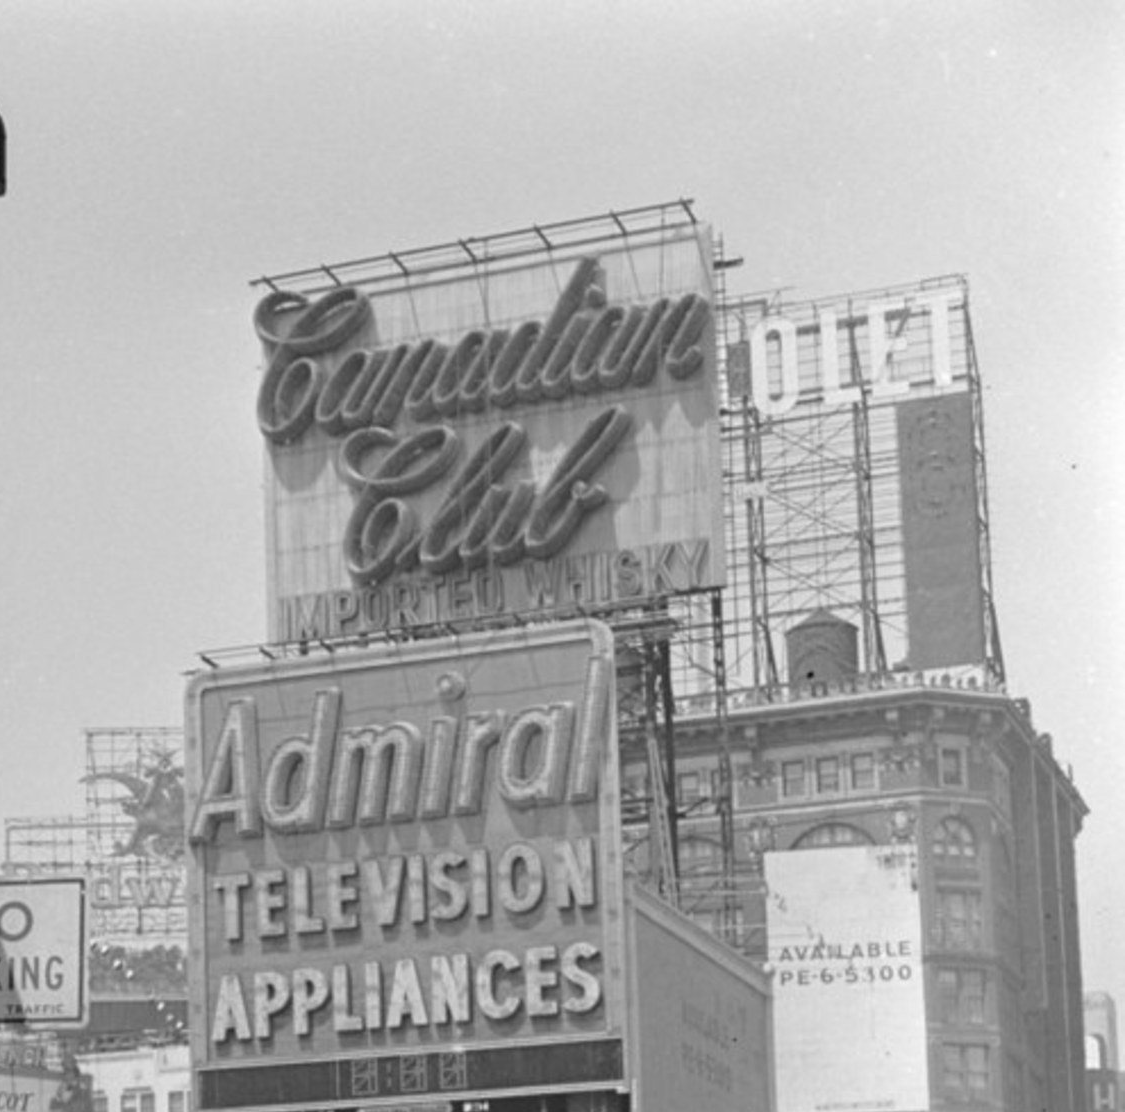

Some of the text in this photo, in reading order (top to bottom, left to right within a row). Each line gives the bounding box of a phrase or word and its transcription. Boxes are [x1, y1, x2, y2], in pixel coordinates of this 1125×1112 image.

[254, 256, 713, 446] Canadian
[340, 404, 632, 586] Club
[280, 538, 710, 642] IMPORTED WHISKY
[189, 655, 613, 848] Admiral
[213, 837, 596, 946] TELEVISION
[211, 941, 604, 1044] APPLIANCES
[779, 940, 912, 963] AVAILABLE
[6, 1003, 64, 1015] TRAFFIC
